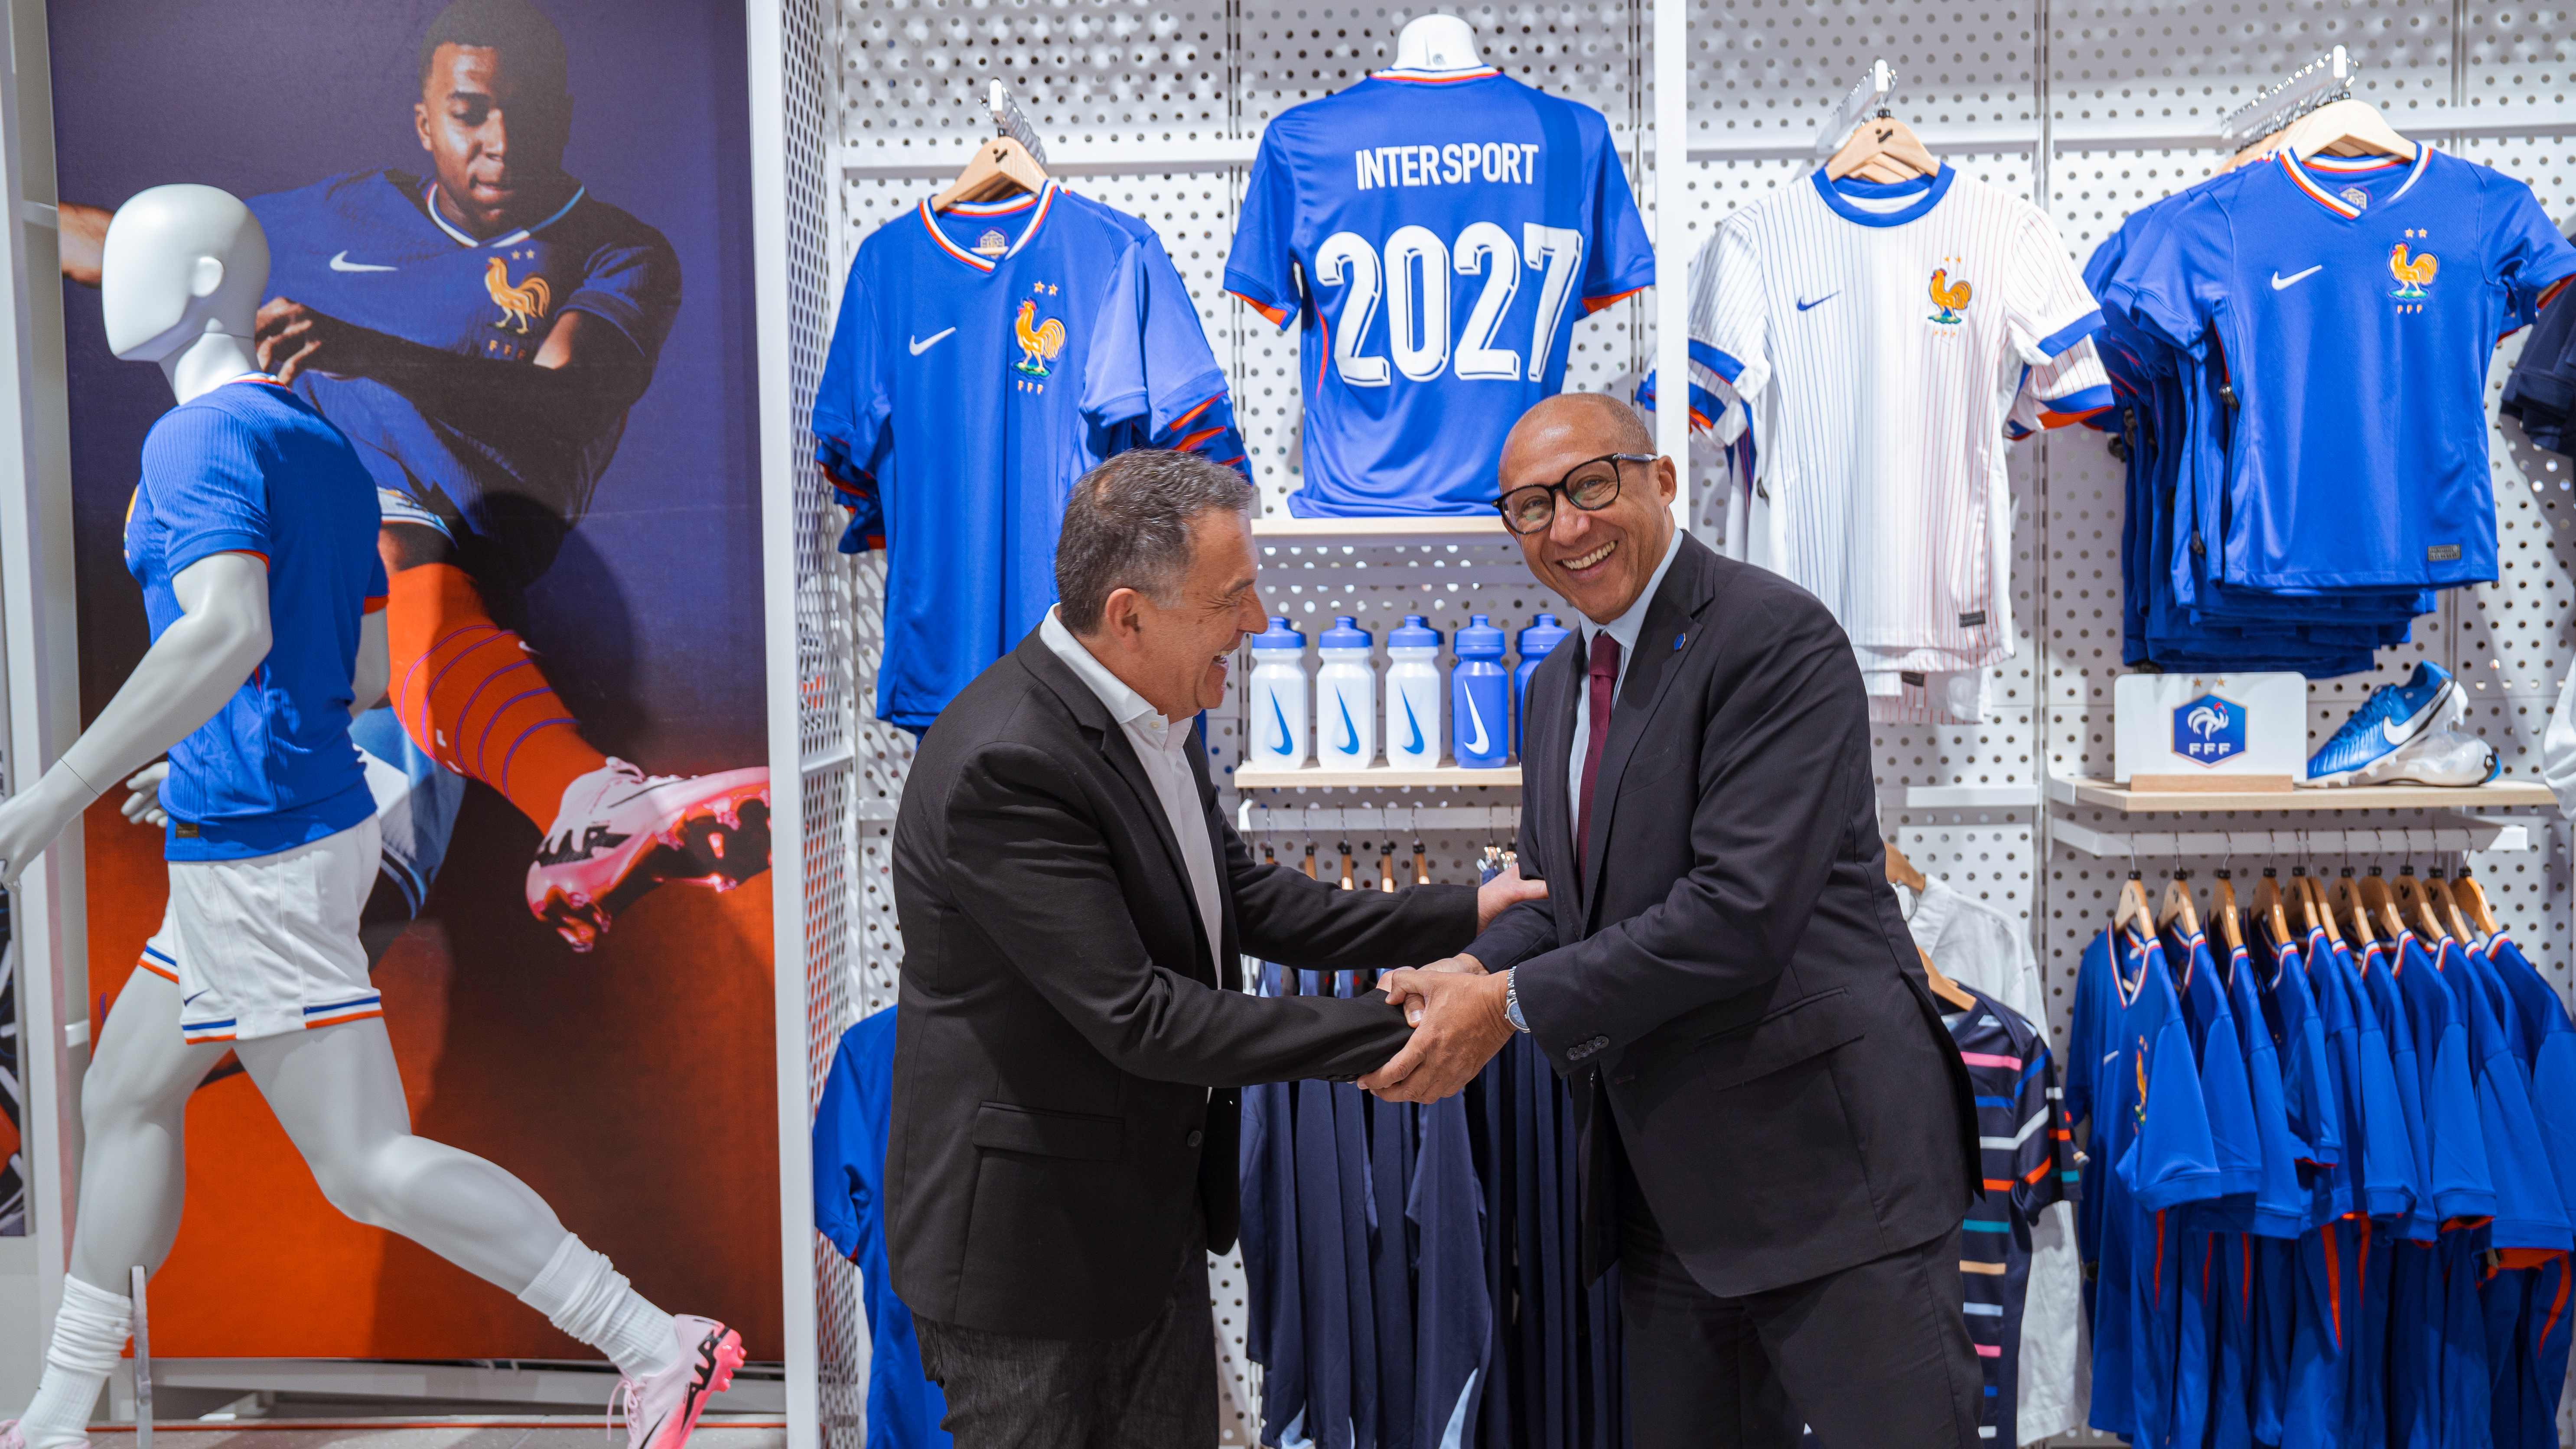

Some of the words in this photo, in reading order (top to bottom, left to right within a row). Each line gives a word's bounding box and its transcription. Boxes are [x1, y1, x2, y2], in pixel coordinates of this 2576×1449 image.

[1355, 143, 1539, 190] INTERSPORT
[1315, 221, 1584, 387] 2027
[2189, 742, 2231, 755] FFF
